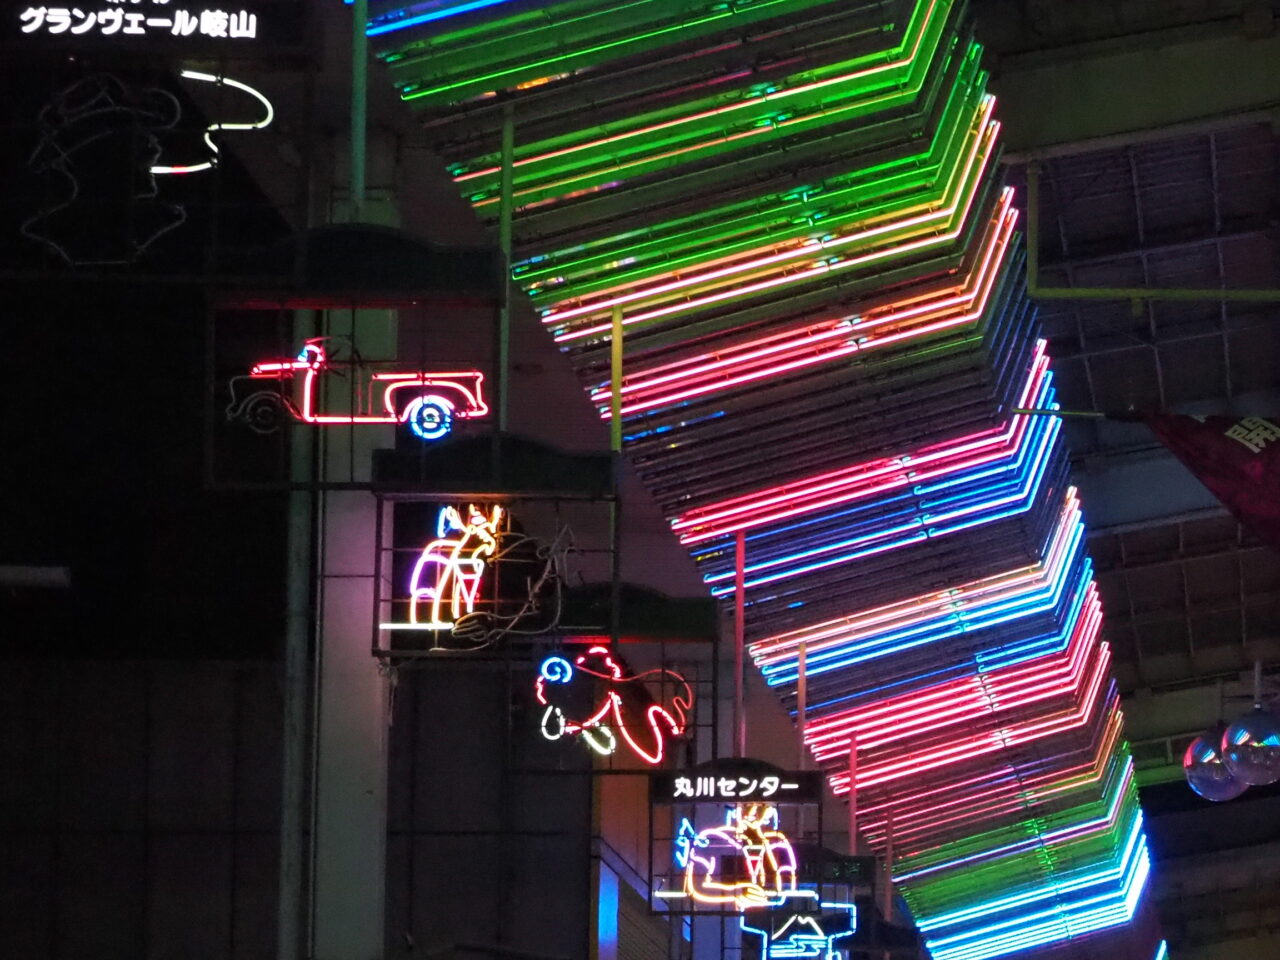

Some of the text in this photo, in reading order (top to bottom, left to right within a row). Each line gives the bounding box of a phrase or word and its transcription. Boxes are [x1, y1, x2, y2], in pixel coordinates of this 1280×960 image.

[20, 6, 257, 38] グランヴェール岐山
[674, 776, 799, 798] 丸川センター
